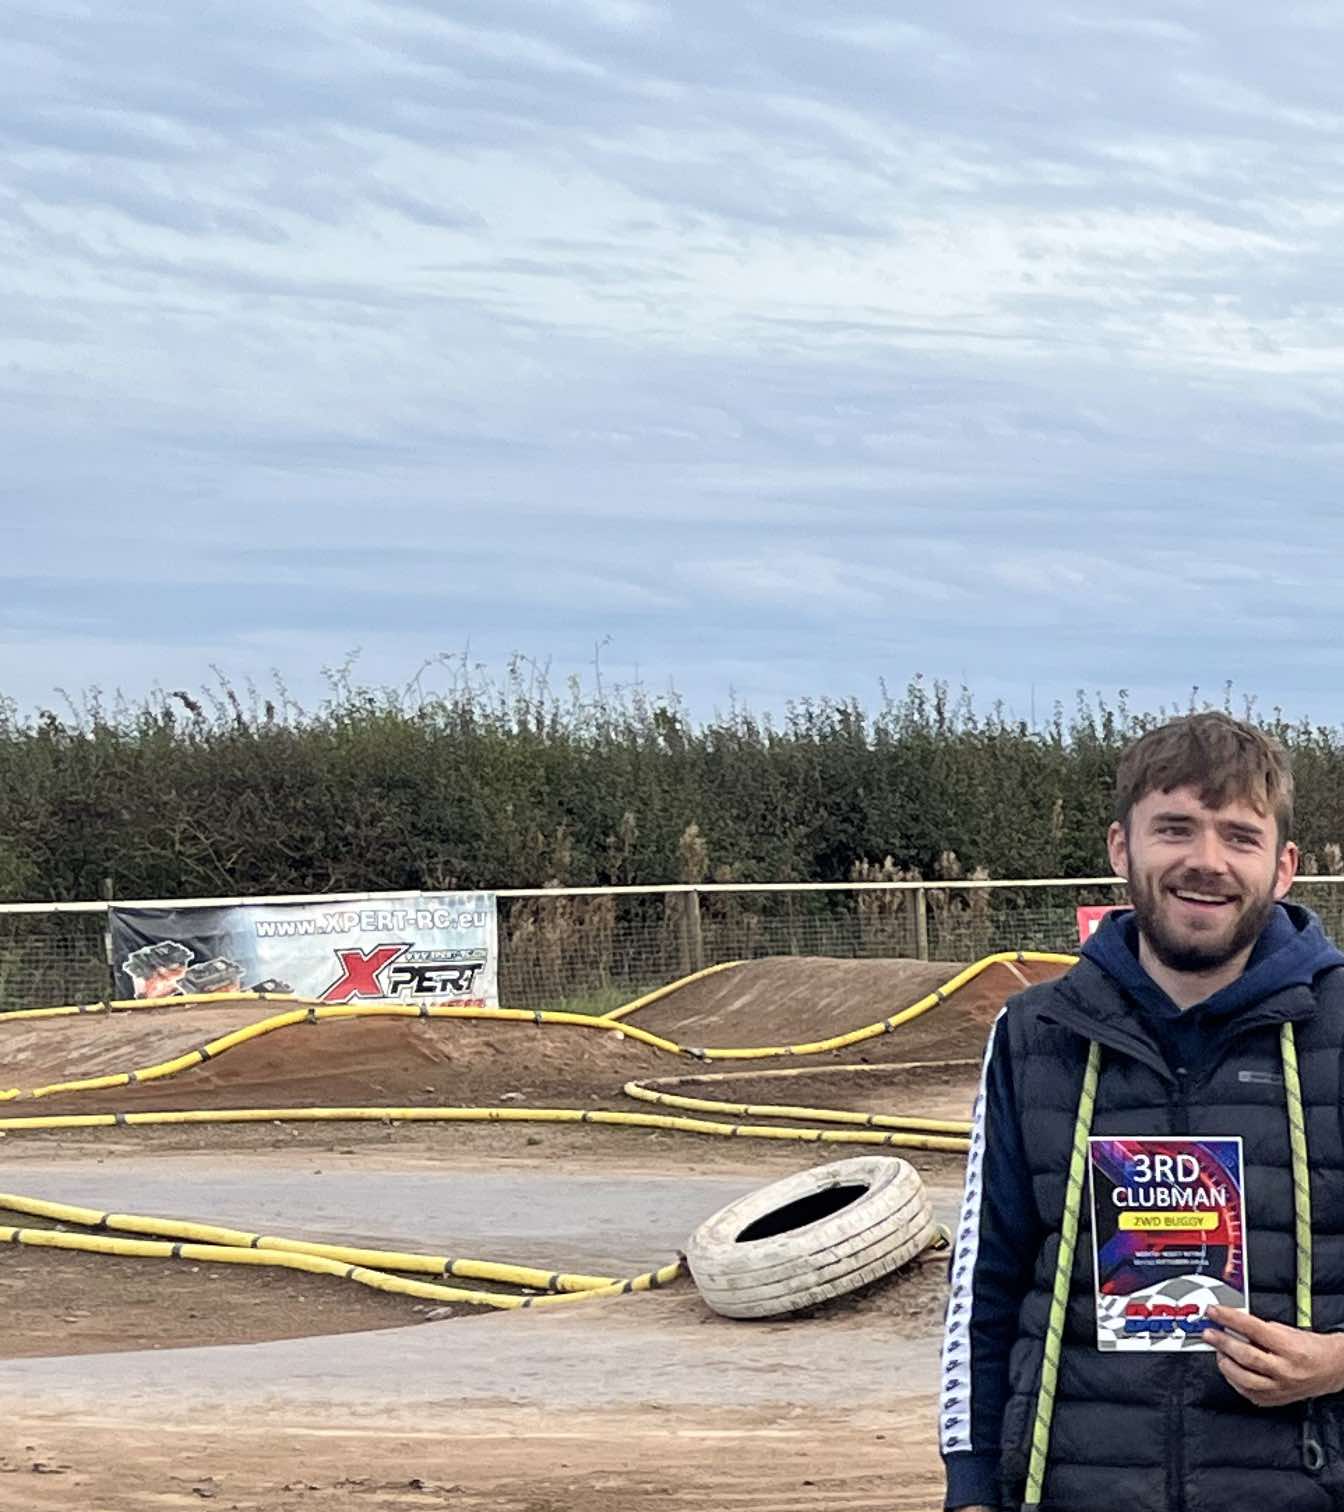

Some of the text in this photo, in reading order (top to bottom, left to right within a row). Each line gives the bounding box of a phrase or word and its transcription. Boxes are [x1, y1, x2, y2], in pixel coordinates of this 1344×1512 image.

[256, 909, 488, 938] www.XPERT-RC.eu
[316, 943, 484, 1004] XPERT
[1133, 1154, 1201, 1183] 3RD
[1112, 1187, 1228, 1207] CLUBMAN
[1134, 1216, 1204, 1227] 2WD BUGGY
